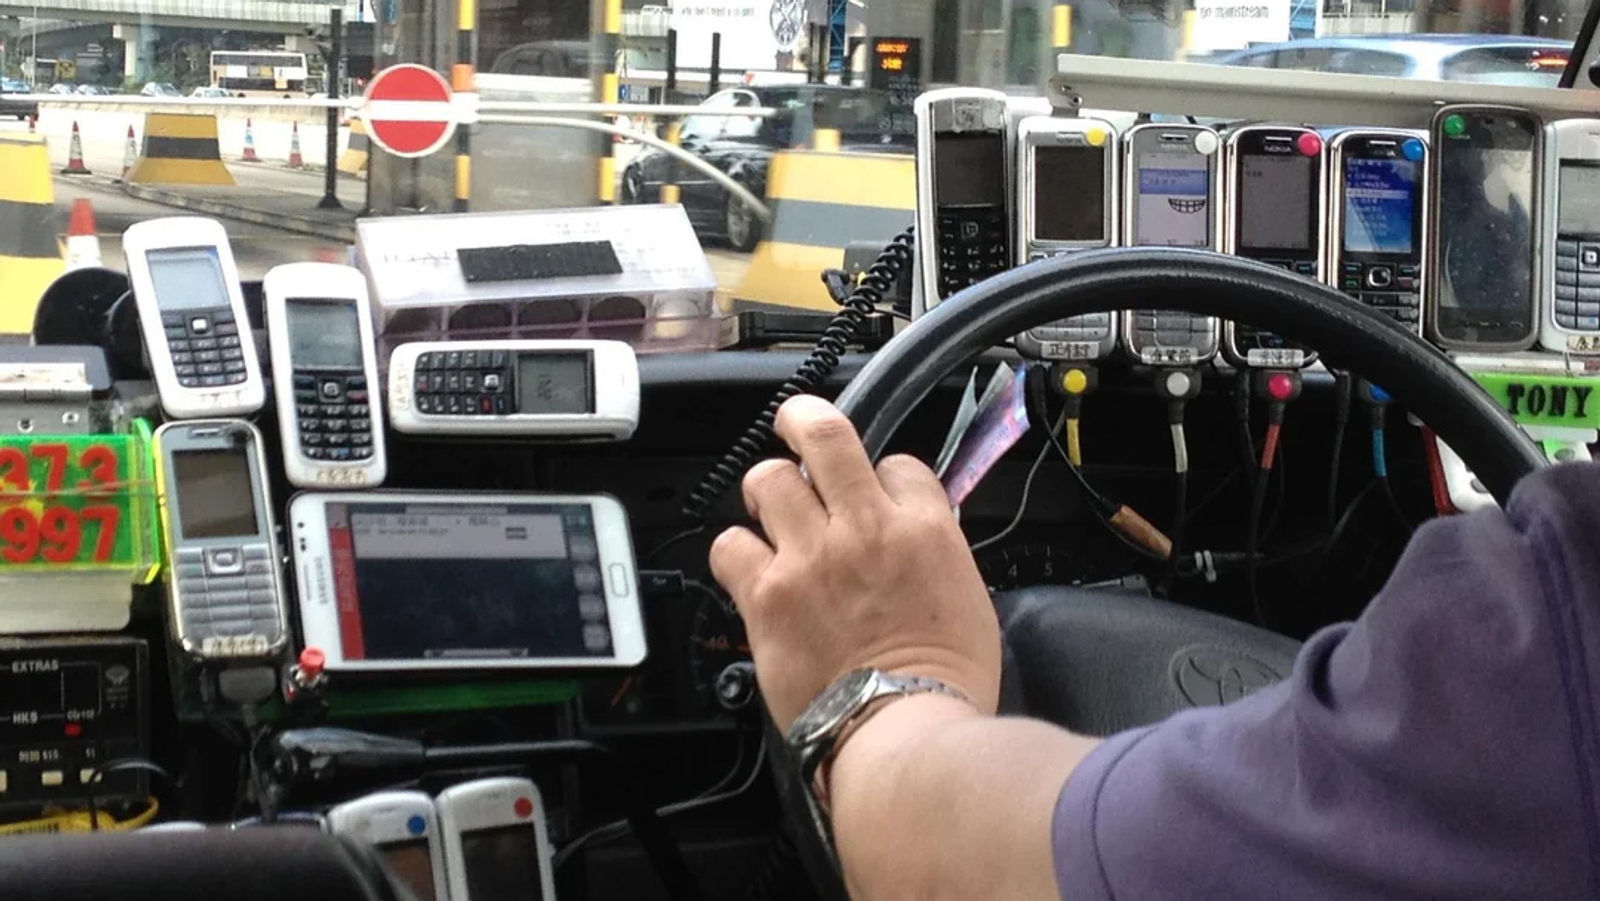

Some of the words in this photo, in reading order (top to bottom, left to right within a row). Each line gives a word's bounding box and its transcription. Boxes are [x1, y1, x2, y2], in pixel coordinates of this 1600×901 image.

[1264, 145, 1292, 154] NOKIA
[1506, 381, 1594, 419] TONY
[0, 504, 121, 564] 997
[11, 659, 60, 674] EXTRAS
